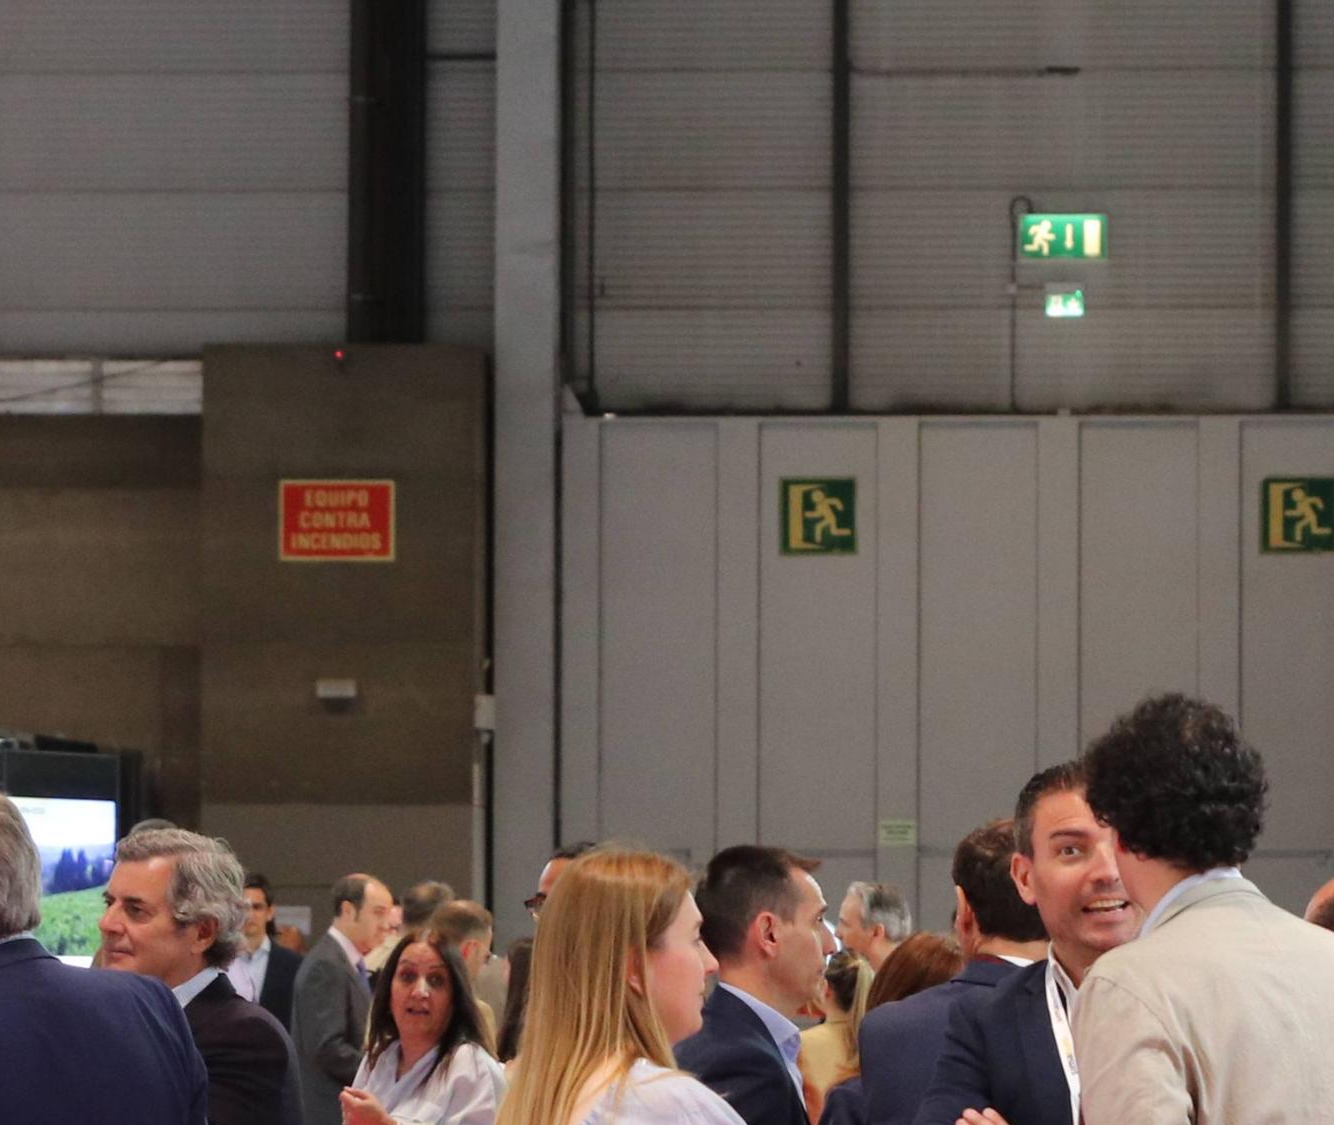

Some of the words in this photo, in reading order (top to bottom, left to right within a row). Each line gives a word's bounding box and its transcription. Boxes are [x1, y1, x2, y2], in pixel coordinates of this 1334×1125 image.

[305, 489, 369, 508] EQUIPO
[298, 511, 371, 529] CONTRA
[290, 532, 382, 551] INCENDIOS
